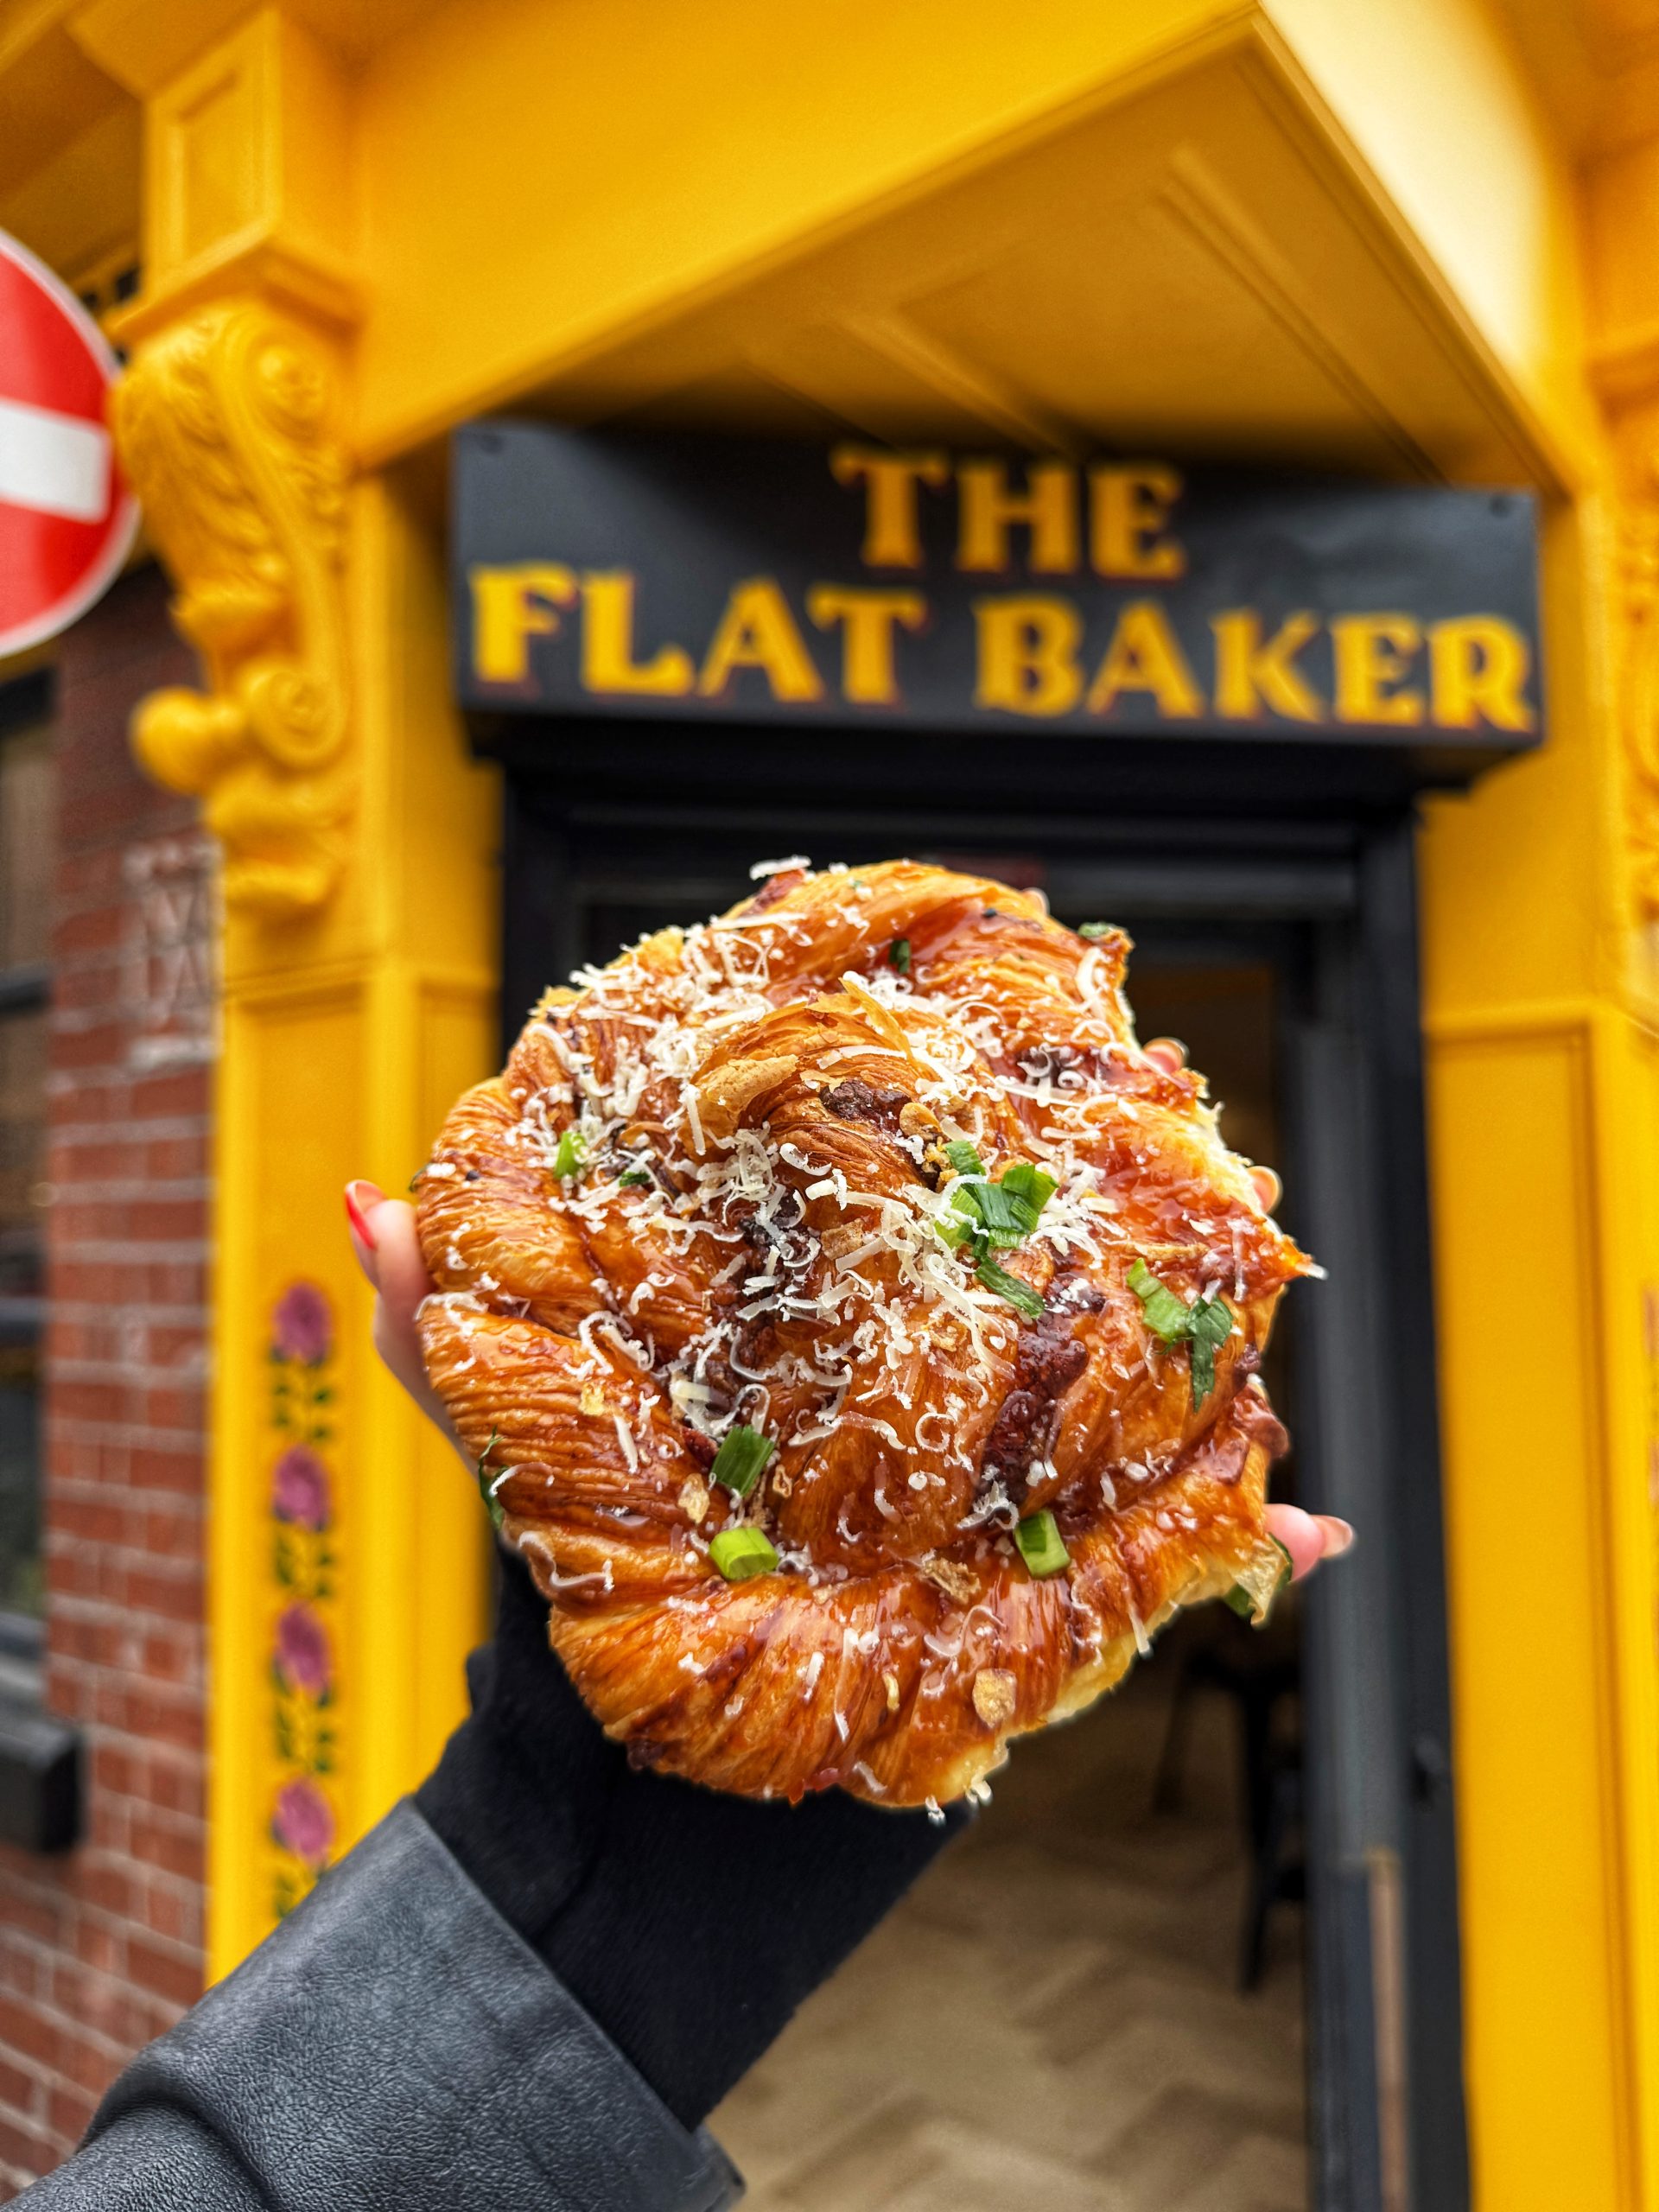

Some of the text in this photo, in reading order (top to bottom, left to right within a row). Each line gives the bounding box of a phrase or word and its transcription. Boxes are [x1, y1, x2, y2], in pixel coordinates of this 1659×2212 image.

[832, 447, 1184, 581] THE
[467, 563, 1536, 733] FLAT BAKER
